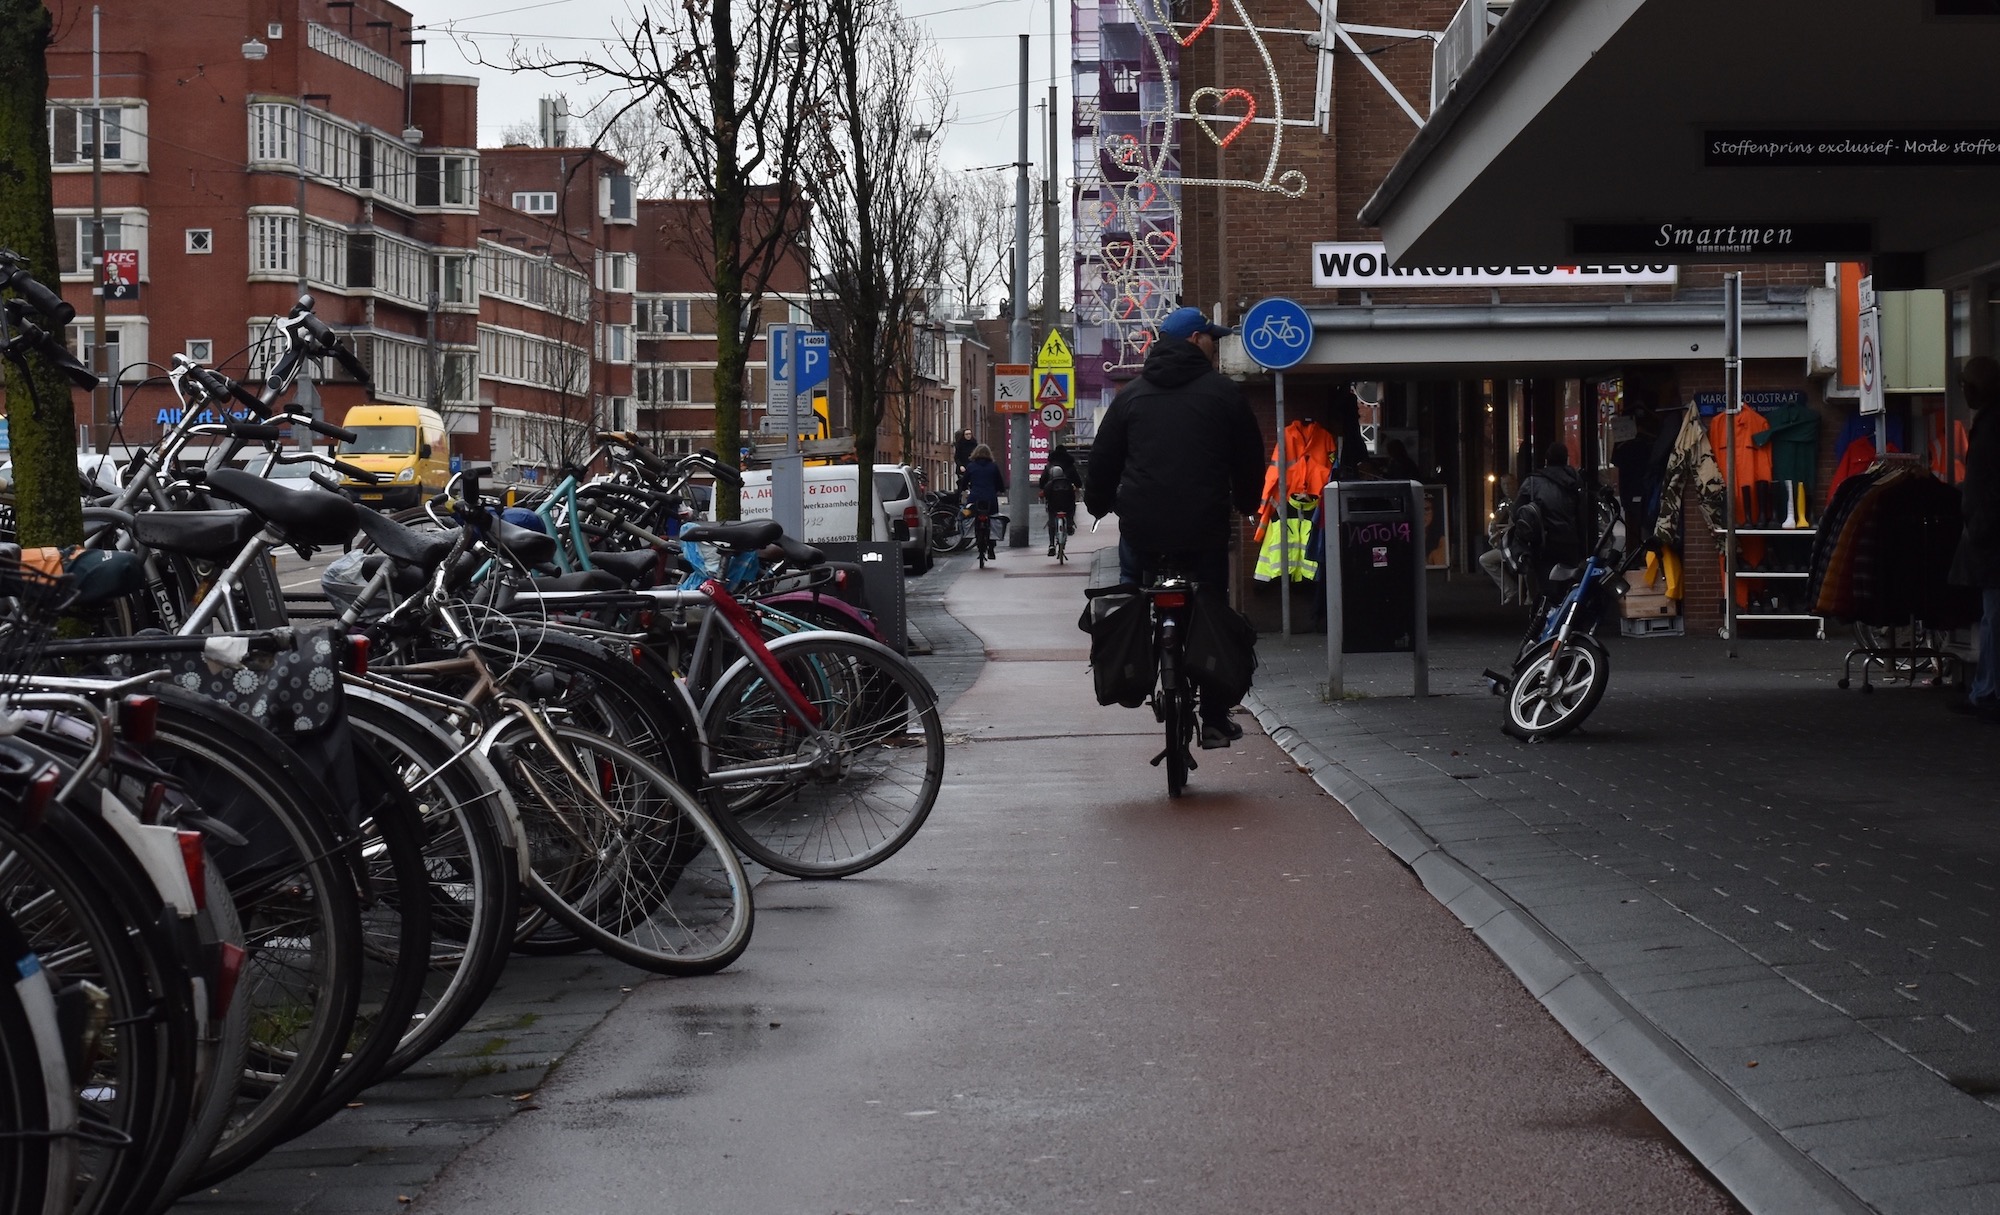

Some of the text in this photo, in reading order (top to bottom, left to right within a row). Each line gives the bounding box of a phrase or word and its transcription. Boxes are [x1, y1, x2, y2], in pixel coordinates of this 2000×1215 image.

[1712, 140, 1815, 157] Stoffenprins
[1818, 139, 1894, 155] exclusief
[1904, 139, 1949, 153] Mode
[1655, 223, 1793, 247] Smartmen
[106, 253, 136, 262] KFC
[805, 350, 819, 374] P
[1700, 393, 1727, 404] MARC
[156, 408, 213, 424] Alrt
[1044, 410, 1062, 421] 30
[809, 485, 817, 495] &
[820, 484, 847, 494] Zoon
[740, 500, 858, 515] dgieters- werkzaamhede
[254, 555, 277, 611] parta
